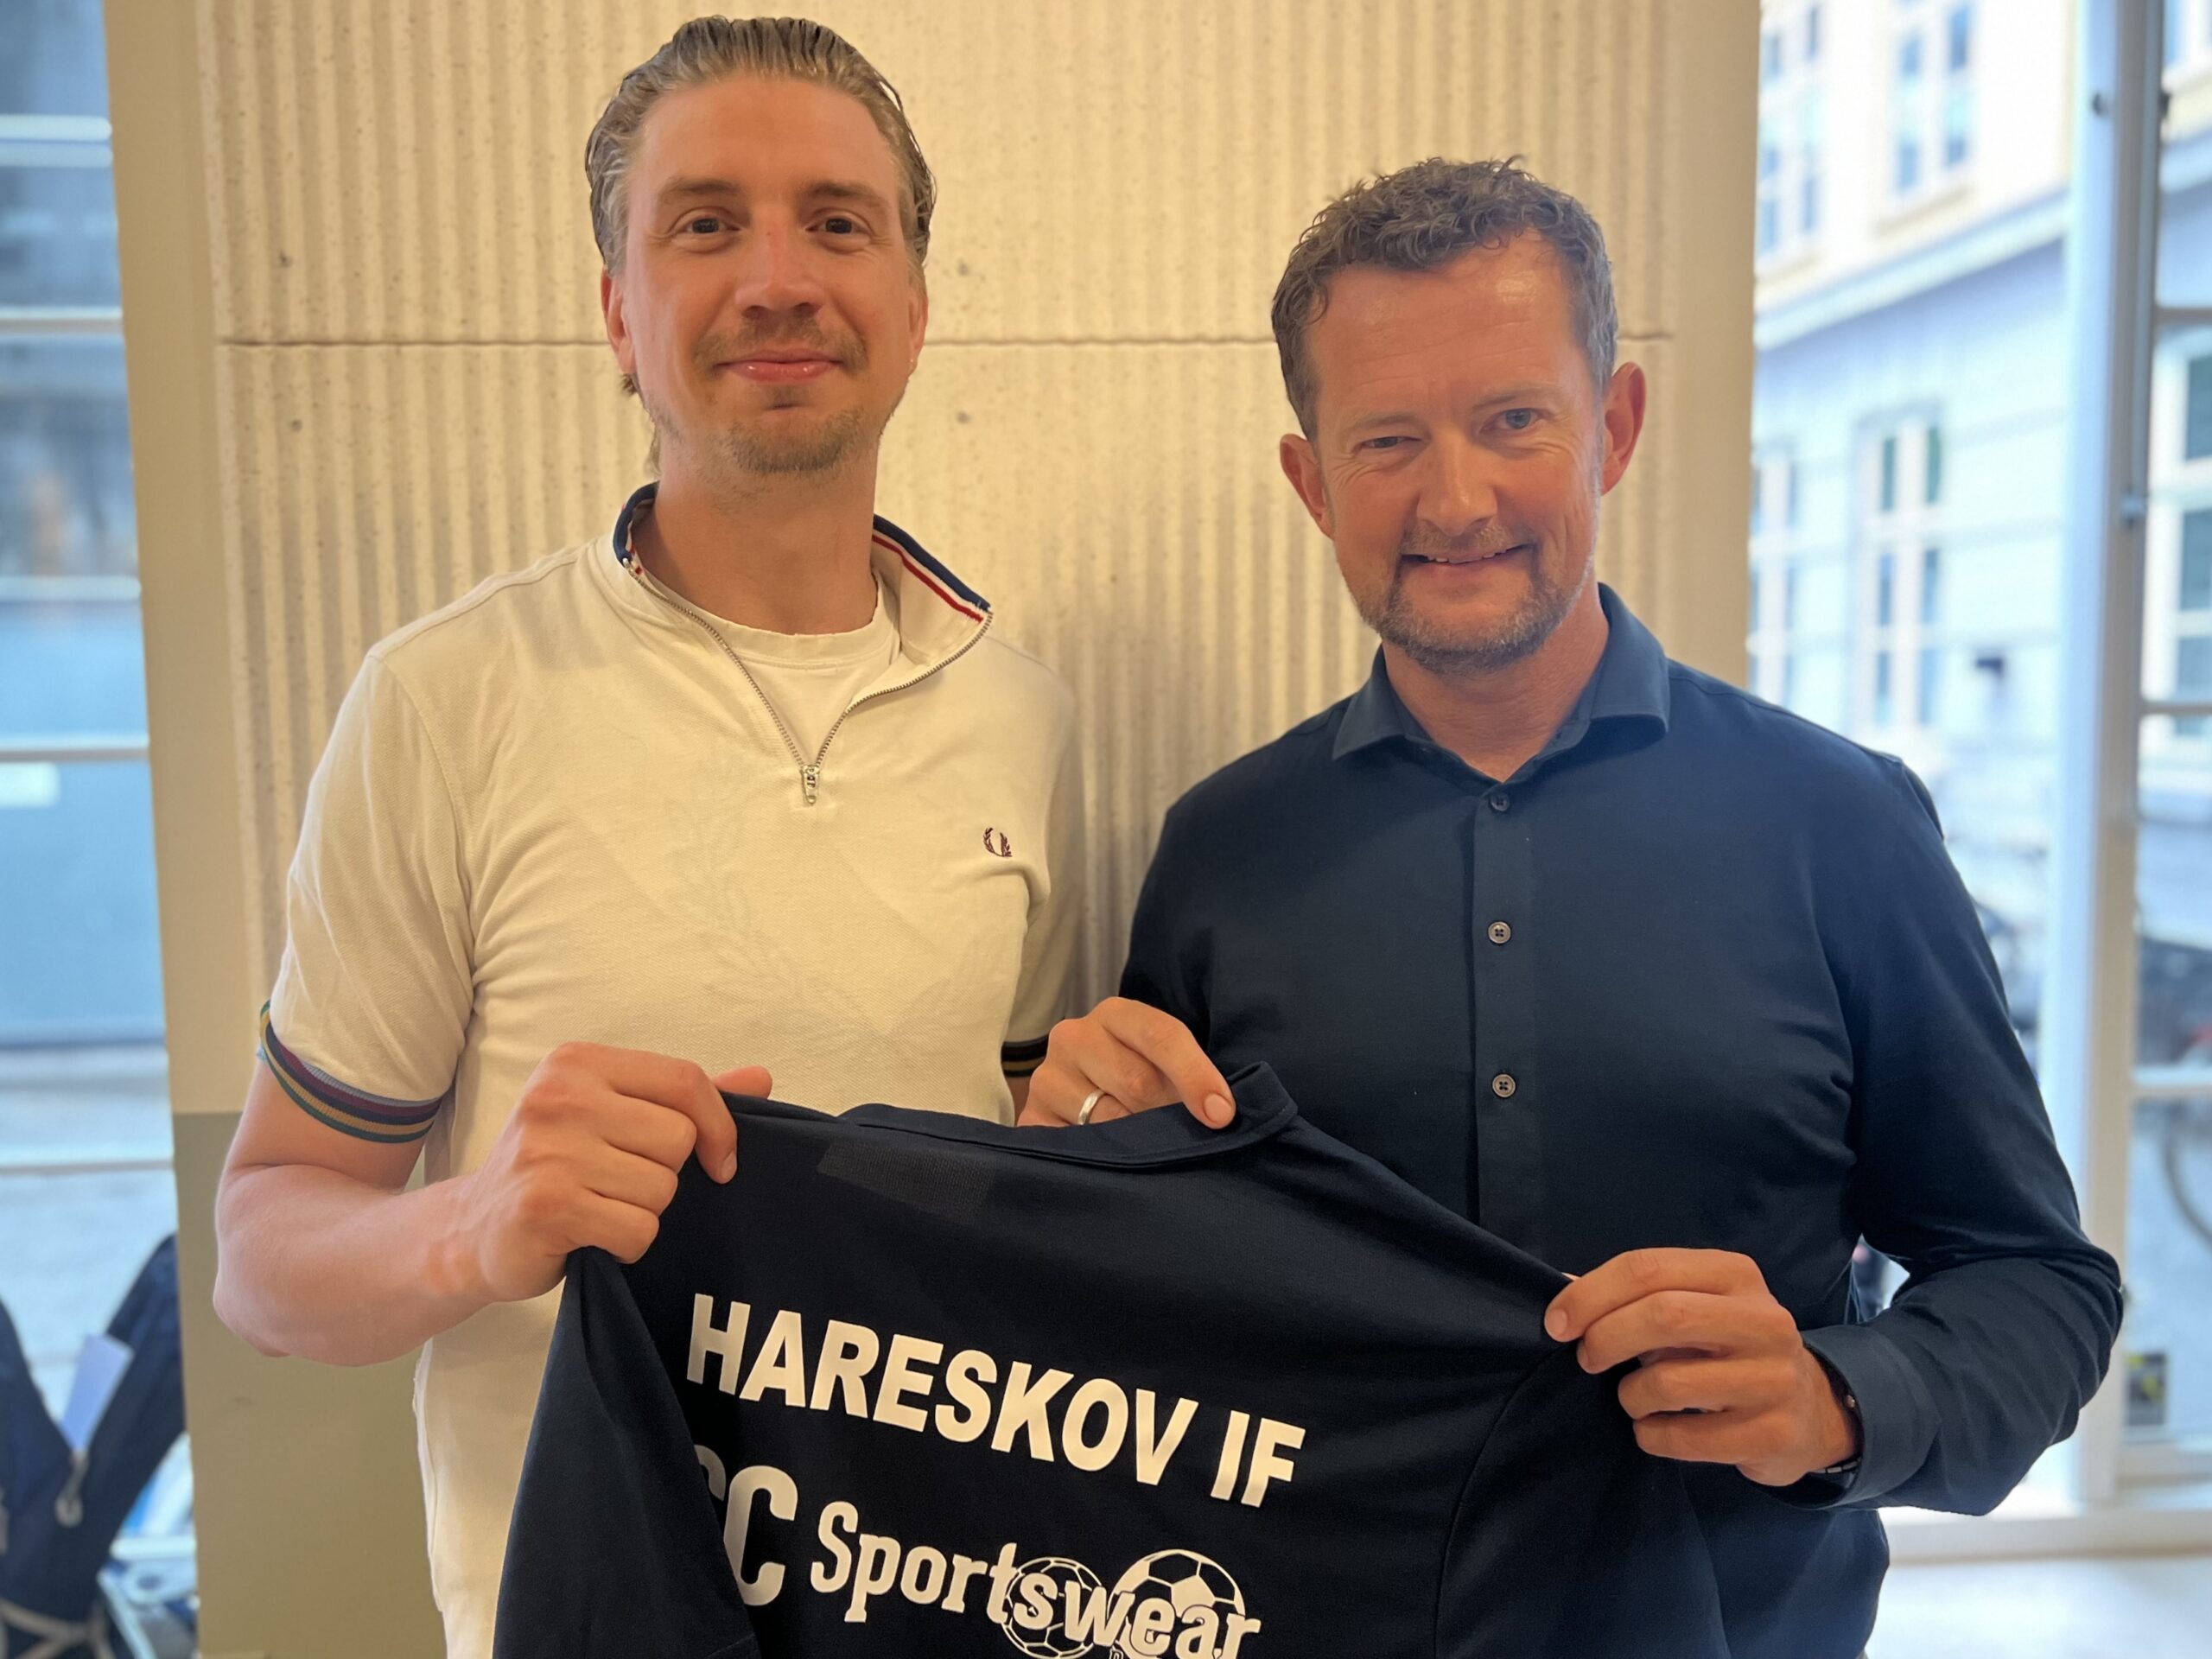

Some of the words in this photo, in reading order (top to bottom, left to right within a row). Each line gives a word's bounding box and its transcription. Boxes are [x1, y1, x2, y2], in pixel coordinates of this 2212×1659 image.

[686, 1293, 1198, 1486] HARESKOV
[1210, 1409, 1306, 1509] IF
[810, 1500, 1262, 1659] Sportswear
